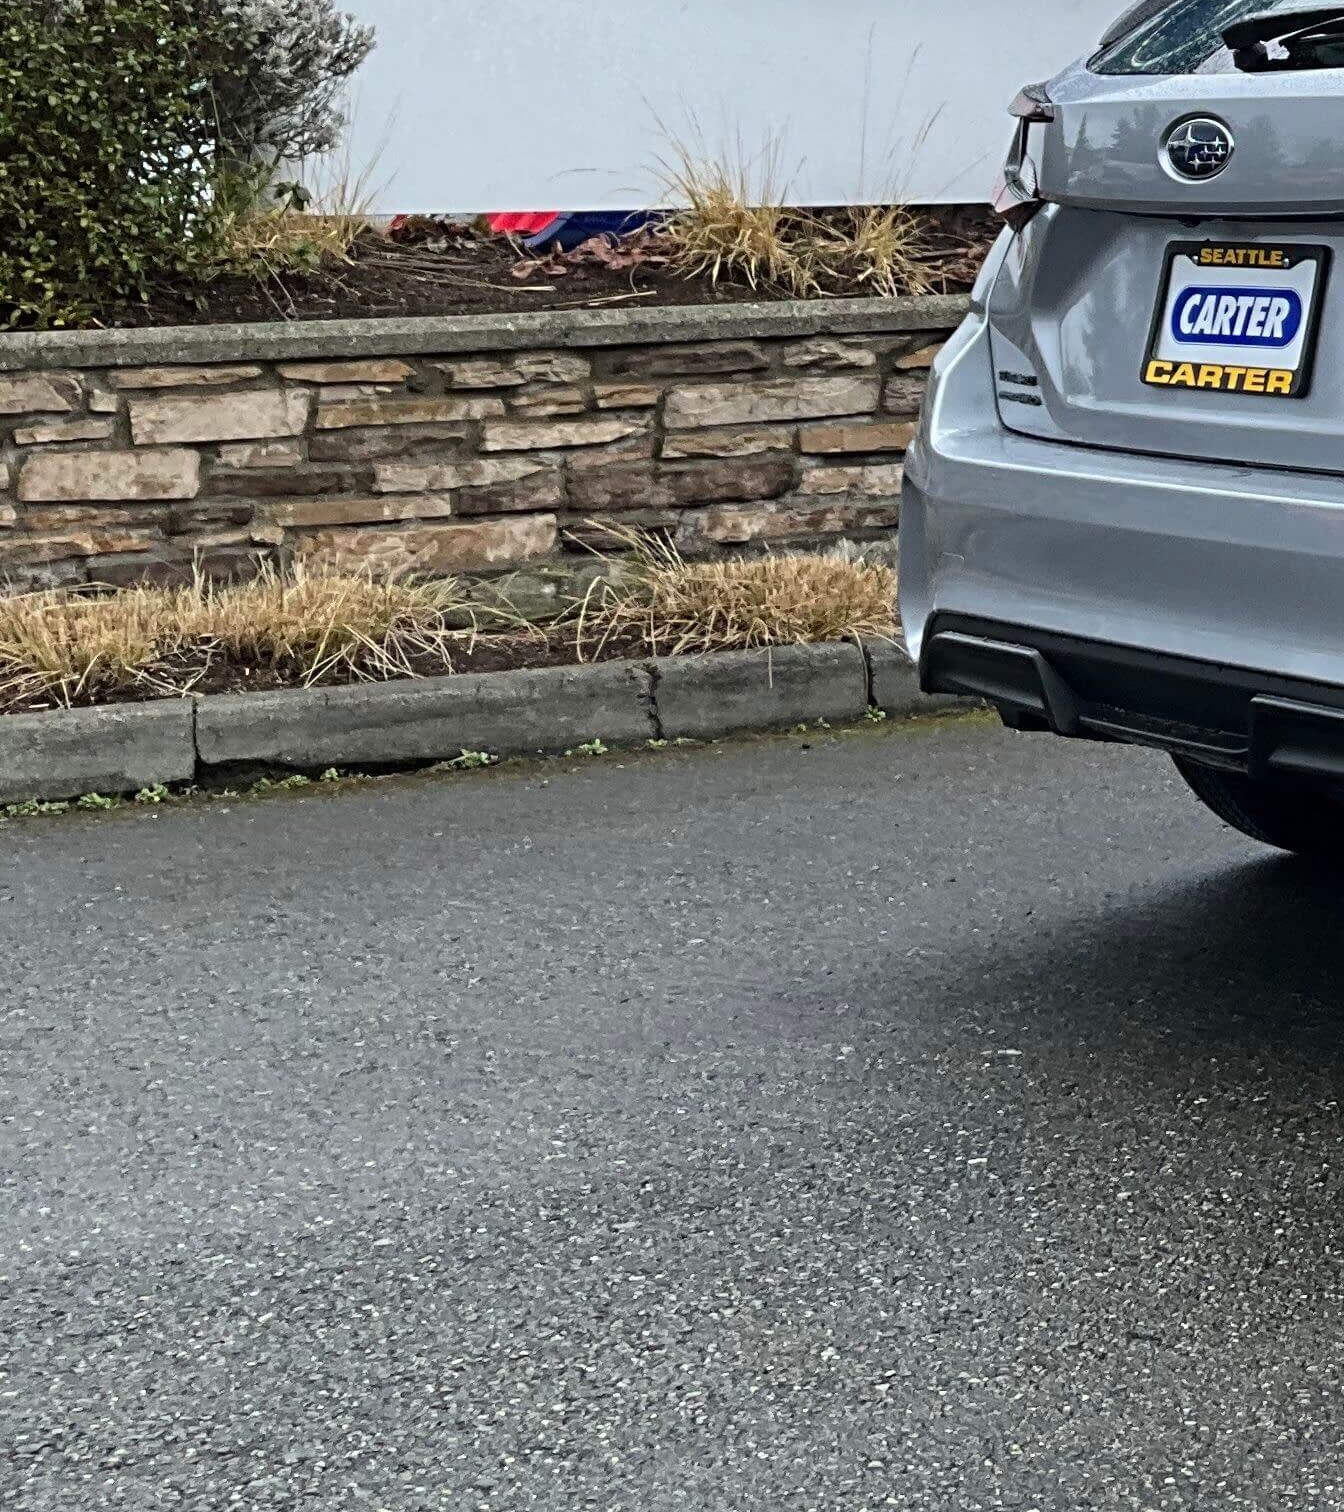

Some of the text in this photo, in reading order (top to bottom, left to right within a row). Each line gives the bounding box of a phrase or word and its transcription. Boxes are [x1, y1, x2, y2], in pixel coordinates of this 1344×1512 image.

[1200, 248, 1284, 266] SEATTLE
[1179, 293, 1291, 339] CARTER
[1145, 360, 1294, 395] CARTER
